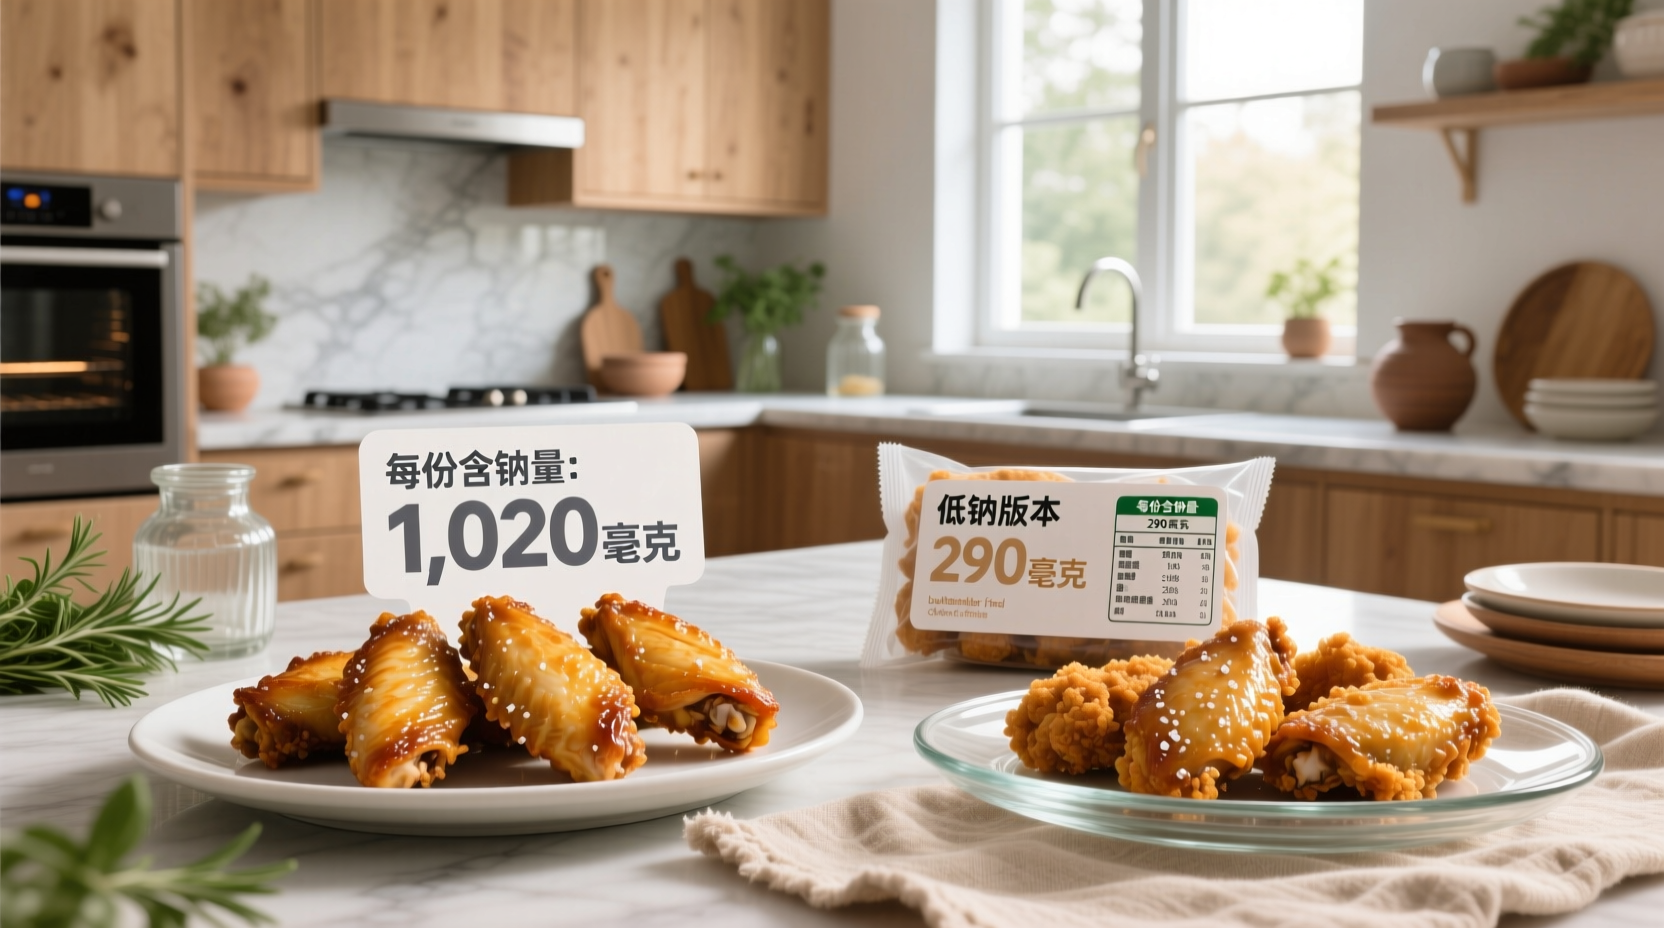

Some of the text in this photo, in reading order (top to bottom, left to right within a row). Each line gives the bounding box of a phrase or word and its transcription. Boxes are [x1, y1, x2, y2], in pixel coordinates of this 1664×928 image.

[385, 448, 579, 490] 每份含钠量:
[937, 494, 1061, 528] 低钠版本
